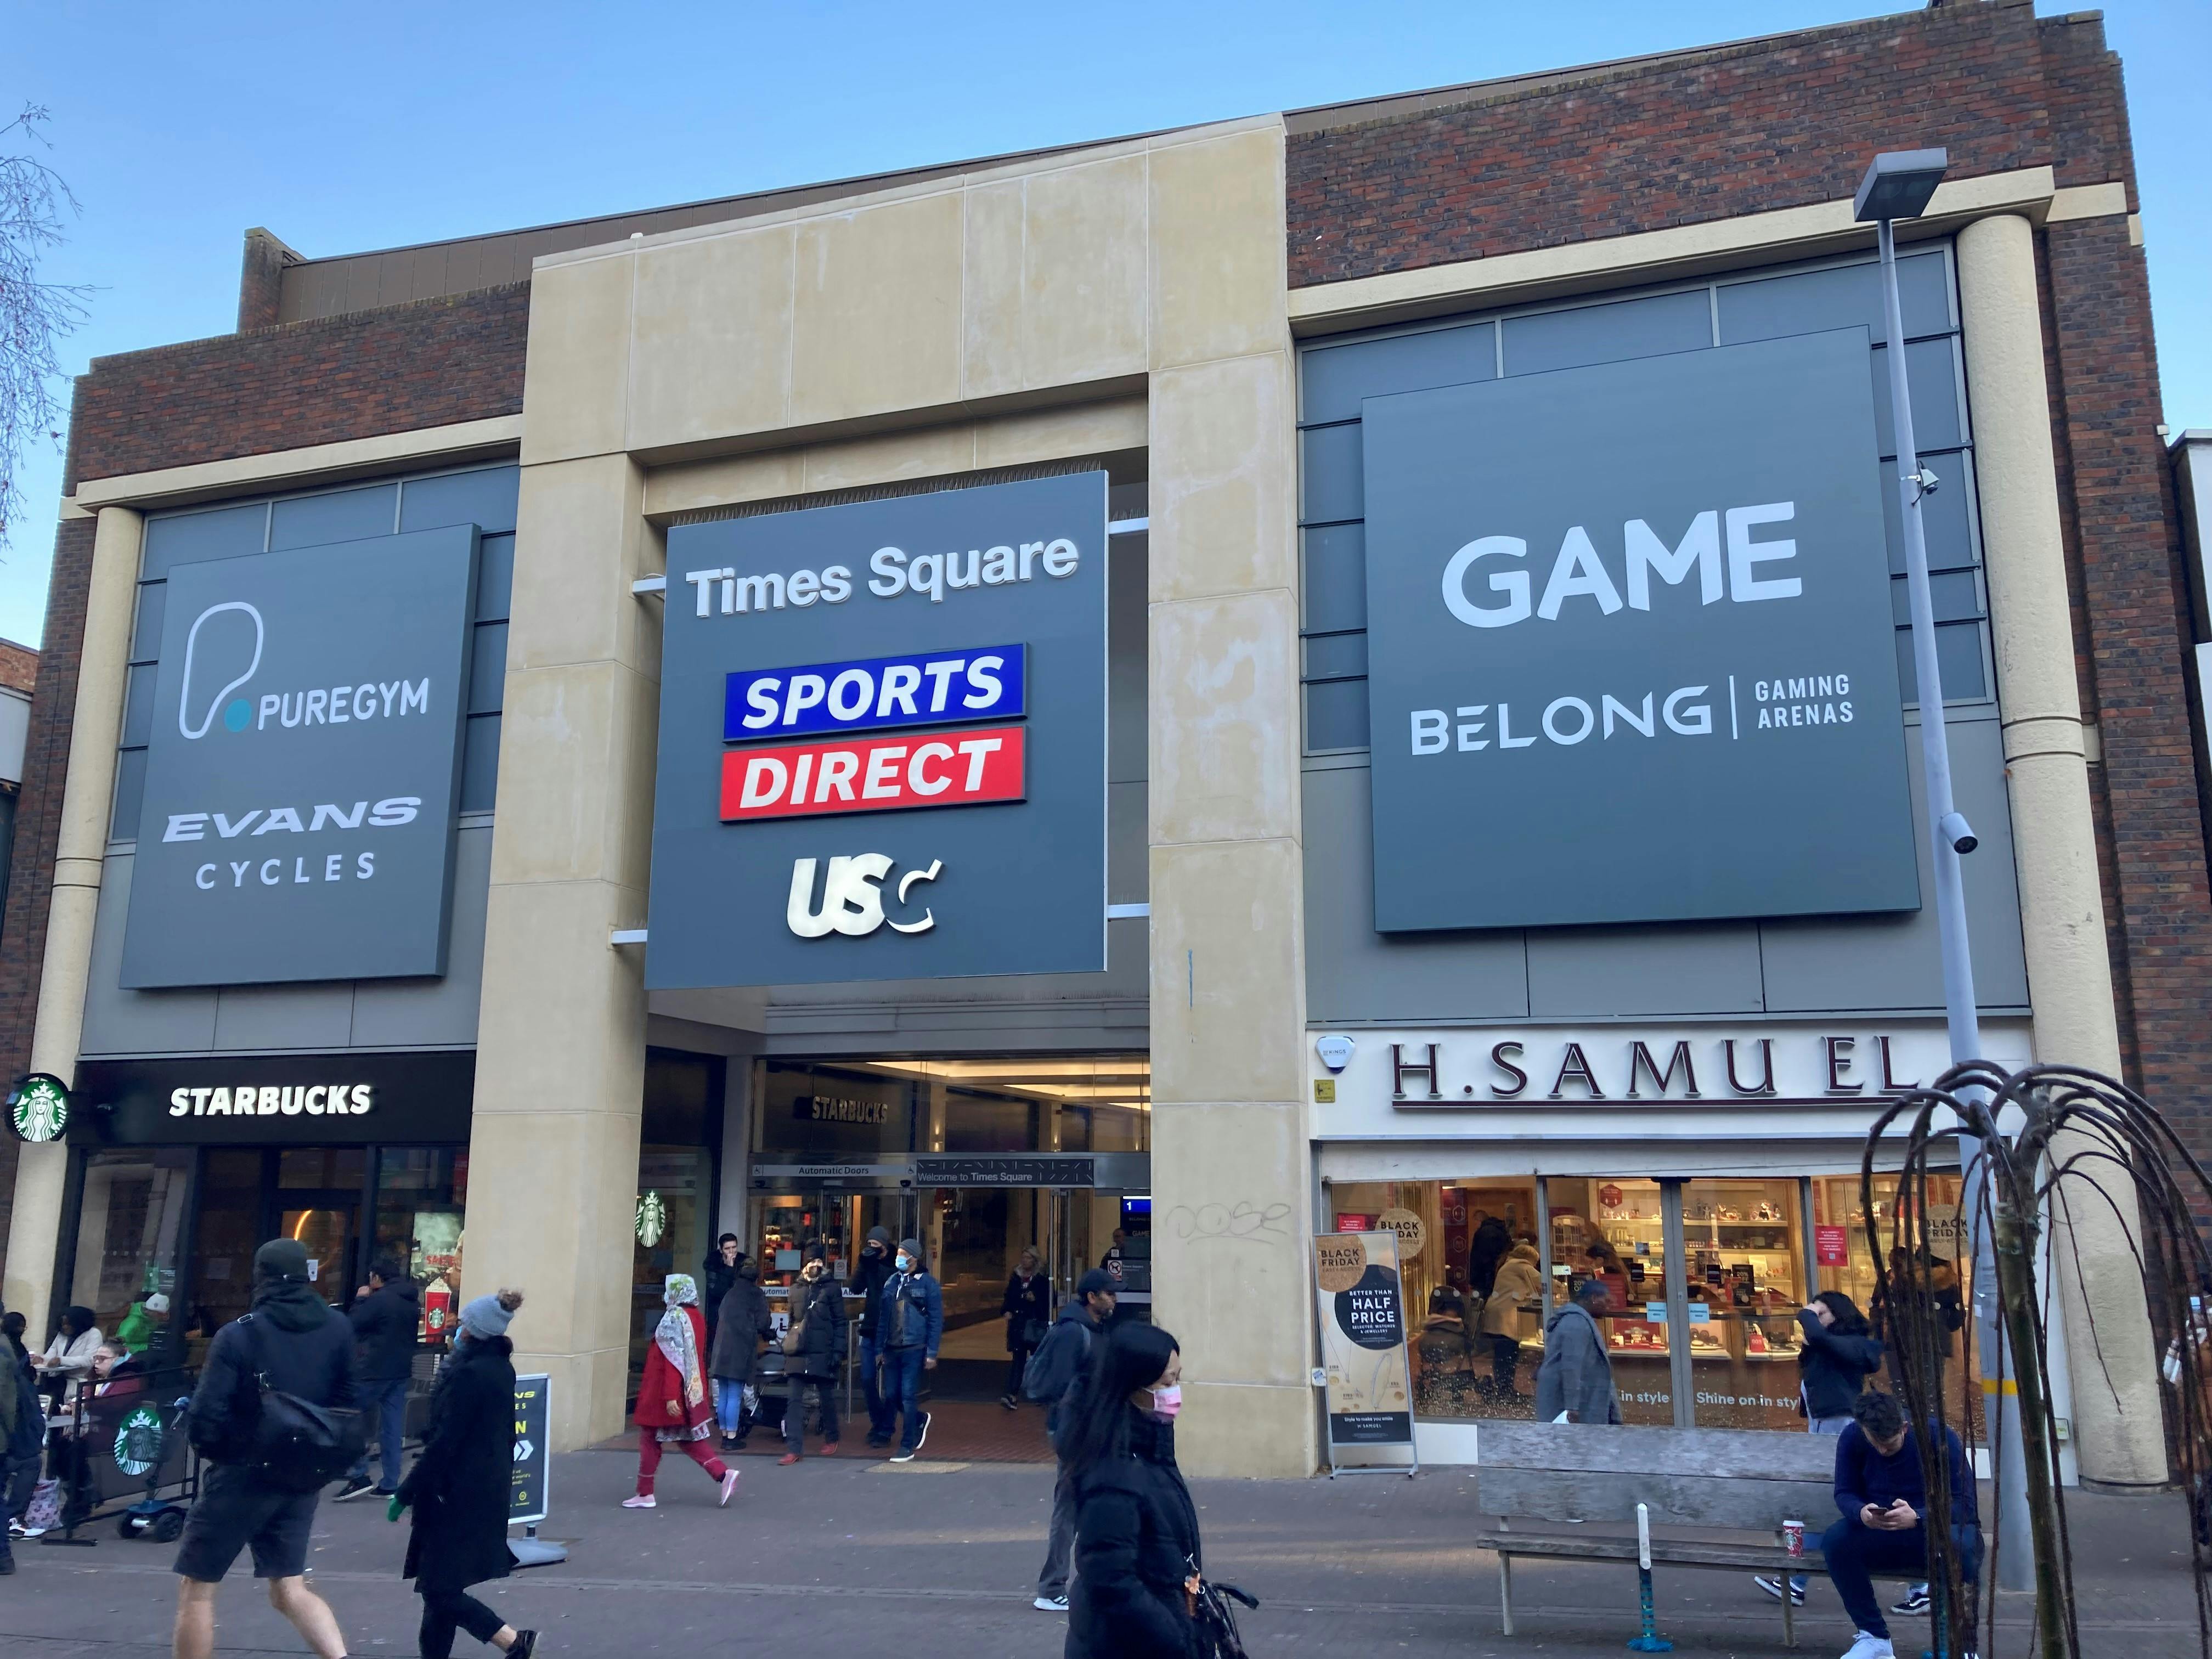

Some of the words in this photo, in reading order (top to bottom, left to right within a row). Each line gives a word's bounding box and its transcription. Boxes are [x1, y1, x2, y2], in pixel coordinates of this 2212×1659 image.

[1442, 501, 1802, 628] GAME
[685, 565, 851, 618] Times
[868, 546, 1079, 603] Square
[742, 656, 1004, 730] SPORTS
[1755, 674, 1850, 702] GAMING
[258, 678, 428, 730] PUREGYM
[1758, 702, 1854, 729] ARENAS
[1410, 686, 1712, 755] BELONG
[739, 737, 1002, 809] DIRECT
[162, 797, 421, 842] EVANS
[196, 852, 375, 889] CYCLES
[787, 853, 944, 938] USC
[168, 1084, 371, 1116] STARBUCKS
[812, 1096, 888, 1124] STARBUCKS
[799, 1166, 842, 1175] Automatic
[844, 1166, 869, 1175] Doors
[918, 1172, 957, 1181] Welcome
[960, 1173, 968, 1181] to
[970, 1172, 998, 1181] Times
[1000, 1172, 1032, 1183] Square
[1126, 1201, 1132, 1210] 1
[1380, 1221, 1419, 1230] BLACK
[1321, 1248, 1359, 1258] BLACK
[1322, 1257, 1360, 1267] FRIDAY
[1351, 1311, 1395, 1324] PRICE
[1352, 1297, 1391, 1310] HALF
[1621, 1390, 1633, 1402] in
[1637, 1391, 1669, 1405] style
[1696, 1392, 1735, 1404] Shine
[1739, 1396, 1756, 1405] on
[1759, 1395, 1773, 1406] in
[1776, 1396, 1801, 1410] styl
